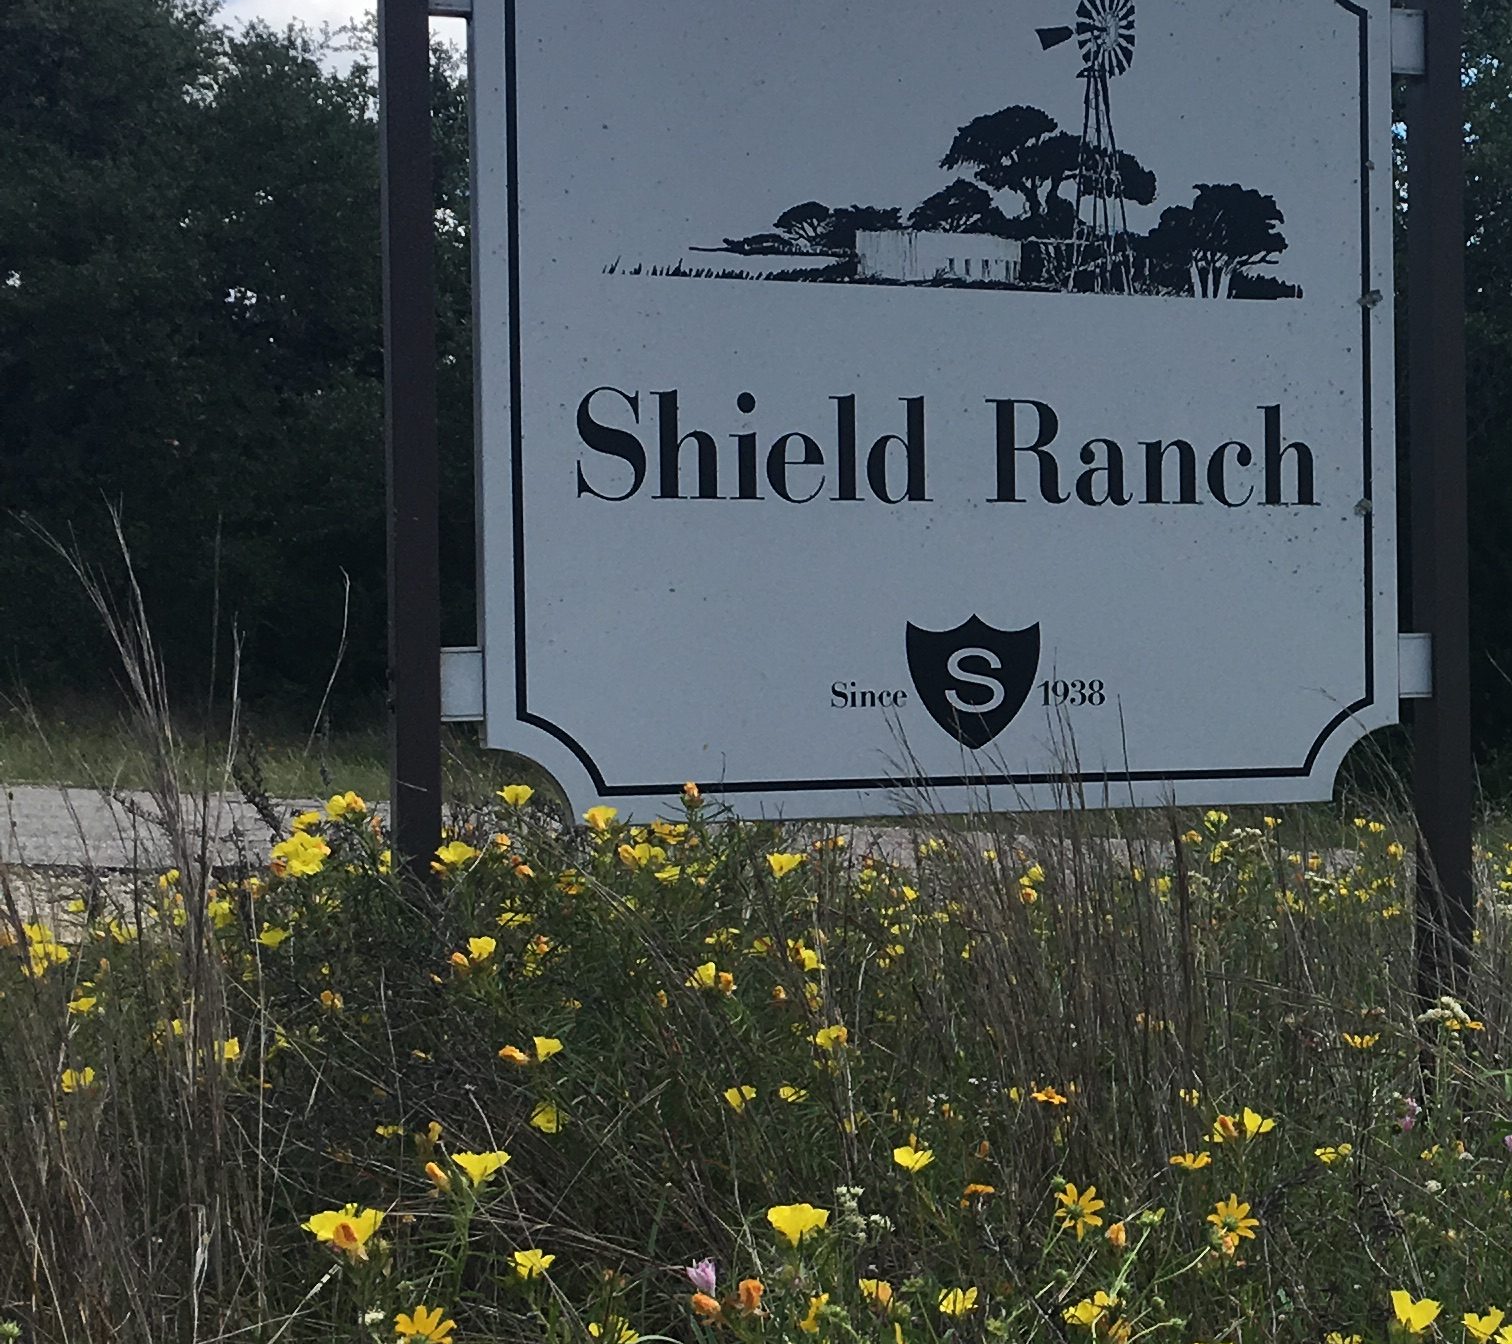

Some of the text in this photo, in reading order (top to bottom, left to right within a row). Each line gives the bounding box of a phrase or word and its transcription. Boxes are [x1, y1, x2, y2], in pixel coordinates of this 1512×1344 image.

[575, 386, 1321, 508] Shield Ranch
[830, 647, 1106, 714] Since S 1938
